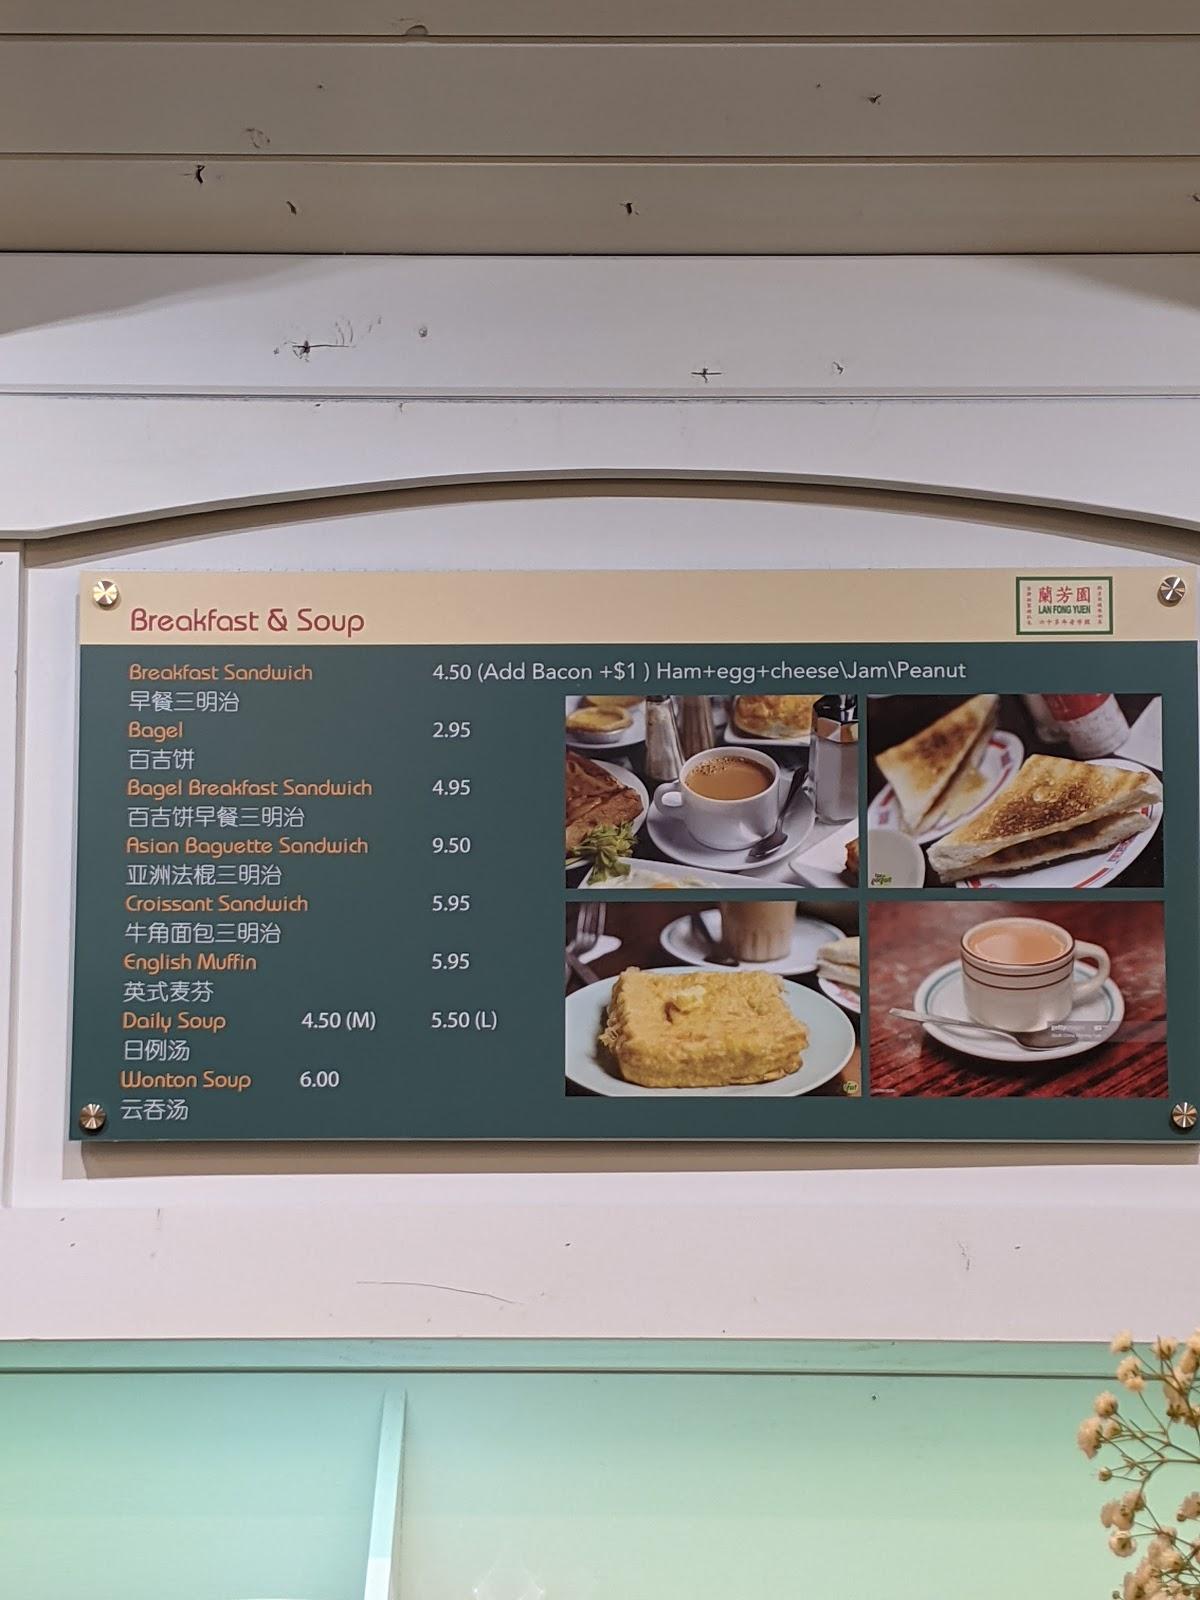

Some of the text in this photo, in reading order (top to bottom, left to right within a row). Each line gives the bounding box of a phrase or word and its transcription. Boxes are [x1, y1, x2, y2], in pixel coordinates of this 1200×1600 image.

[1038, 586, 1091, 603] 蘭芳園
[1038, 605, 1091, 614] LAN FONG YUEN
[130, 607, 365, 638] Breakfast & Soup
[129, 664, 313, 681] Breakfast Sandwich
[432, 664, 472, 680] 4.50
[477, 662, 526, 683] (Add
[532, 663, 593, 680] Bacon
[128, 690, 240, 713] 早餐三明治
[128, 720, 183, 743] Bagel
[432, 721, 472, 739] 2.95
[128, 748, 195, 771] 百吉饼
[127, 778, 373, 800] Bagel Breakfast Sandwich
[432, 779, 472, 796] 4.95
[127, 805, 305, 829] 百吉饼早餐三明治
[126, 836, 369, 858] Asian Baguette Sandwich
[432, 836, 472, 854] 9.50
[126, 863, 283, 887] 亚洲法棍三明治
[125, 895, 309, 912] Croissant Sandwich
[431, 895, 471, 912] 5.95
[124, 921, 282, 945] 牛角面包三明治
[123, 952, 257, 976] English Muffin
[431, 952, 471, 970] 5.95
[122, 979, 215, 1003] 英式麦芬
[122, 1012, 227, 1034] Daily Soup
[301, 1010, 377, 1032] 4.50 (M)
[431, 1009, 498, 1032] 5.50 (L)
[124, 1039, 191, 1063] 日例汤
[120, 1070, 253, 1092] Wonton Soup
[299, 1069, 341, 1088] 6.00
[120, 1098, 190, 1121] 云吞汤
